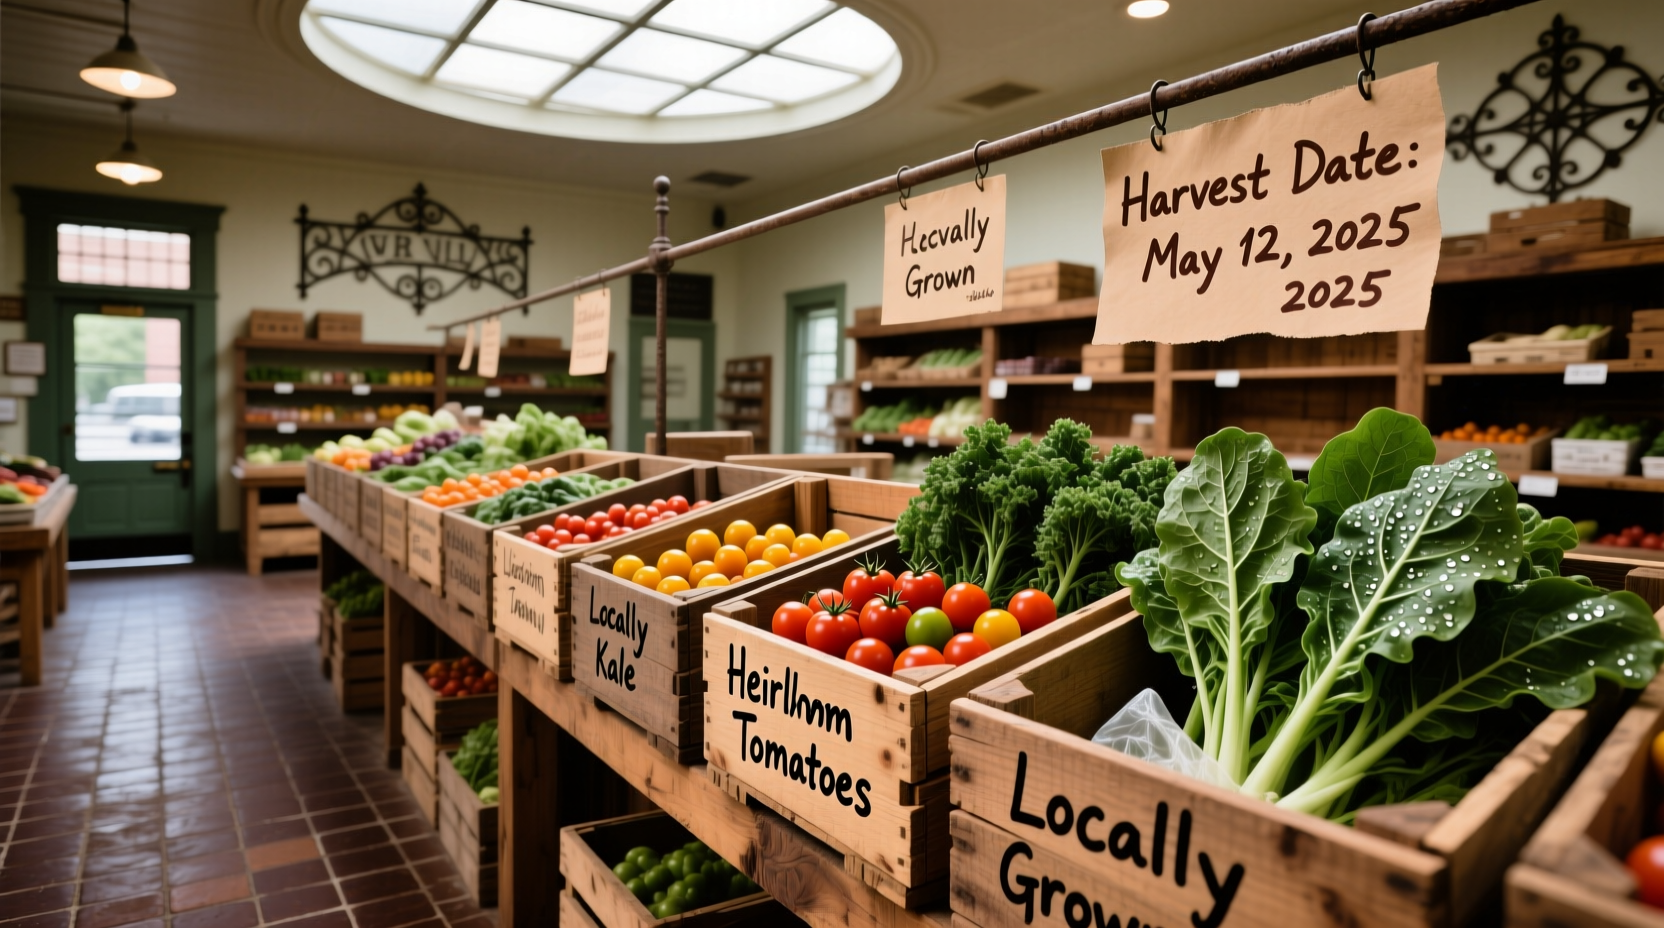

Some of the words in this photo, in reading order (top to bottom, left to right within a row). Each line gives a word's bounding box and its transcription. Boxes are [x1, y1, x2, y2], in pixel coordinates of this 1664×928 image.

[1121, 152, 1271, 227] Harvest
[1291, 130, 1419, 196] Date:
[905, 264, 975, 299] Grown
[1141, 230, 1223, 295] May
[1239, 224, 1293, 270] 12,
[1307, 202, 1422, 257] 2025
[1280, 269, 1392, 313] 2025
[588, 584, 649, 659] Locally
[595, 636, 637, 692] Kale
[732, 710, 873, 818] Tomatoes
[1010, 751, 1245, 928] Locally
